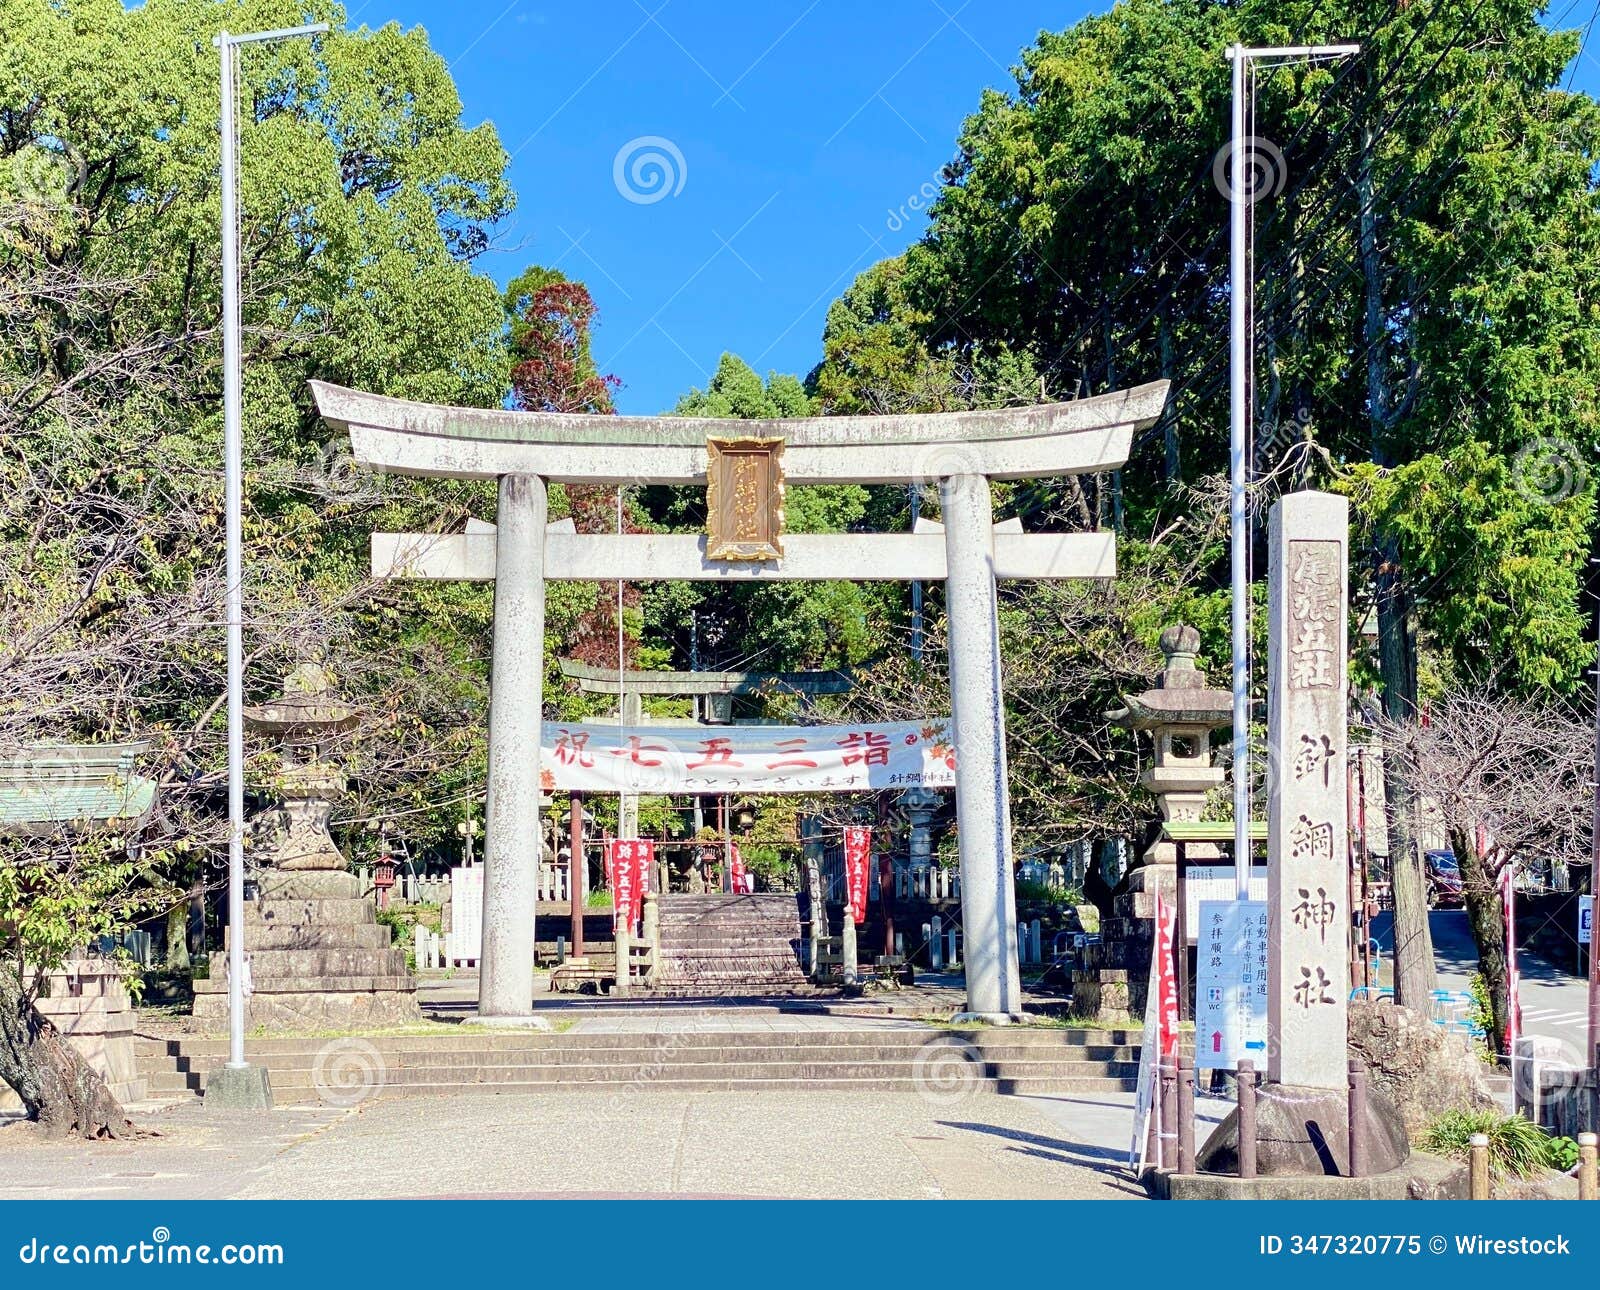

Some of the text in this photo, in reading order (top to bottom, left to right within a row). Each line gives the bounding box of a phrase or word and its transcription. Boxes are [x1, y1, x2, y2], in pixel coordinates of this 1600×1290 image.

[554, 729, 892, 769] 祝七五三詣
[631, 774, 859, 789] でとうございます
[1290, 734, 1337, 1009] 針綱神社
[1256, 913, 1268, 996] 自動車専用道
